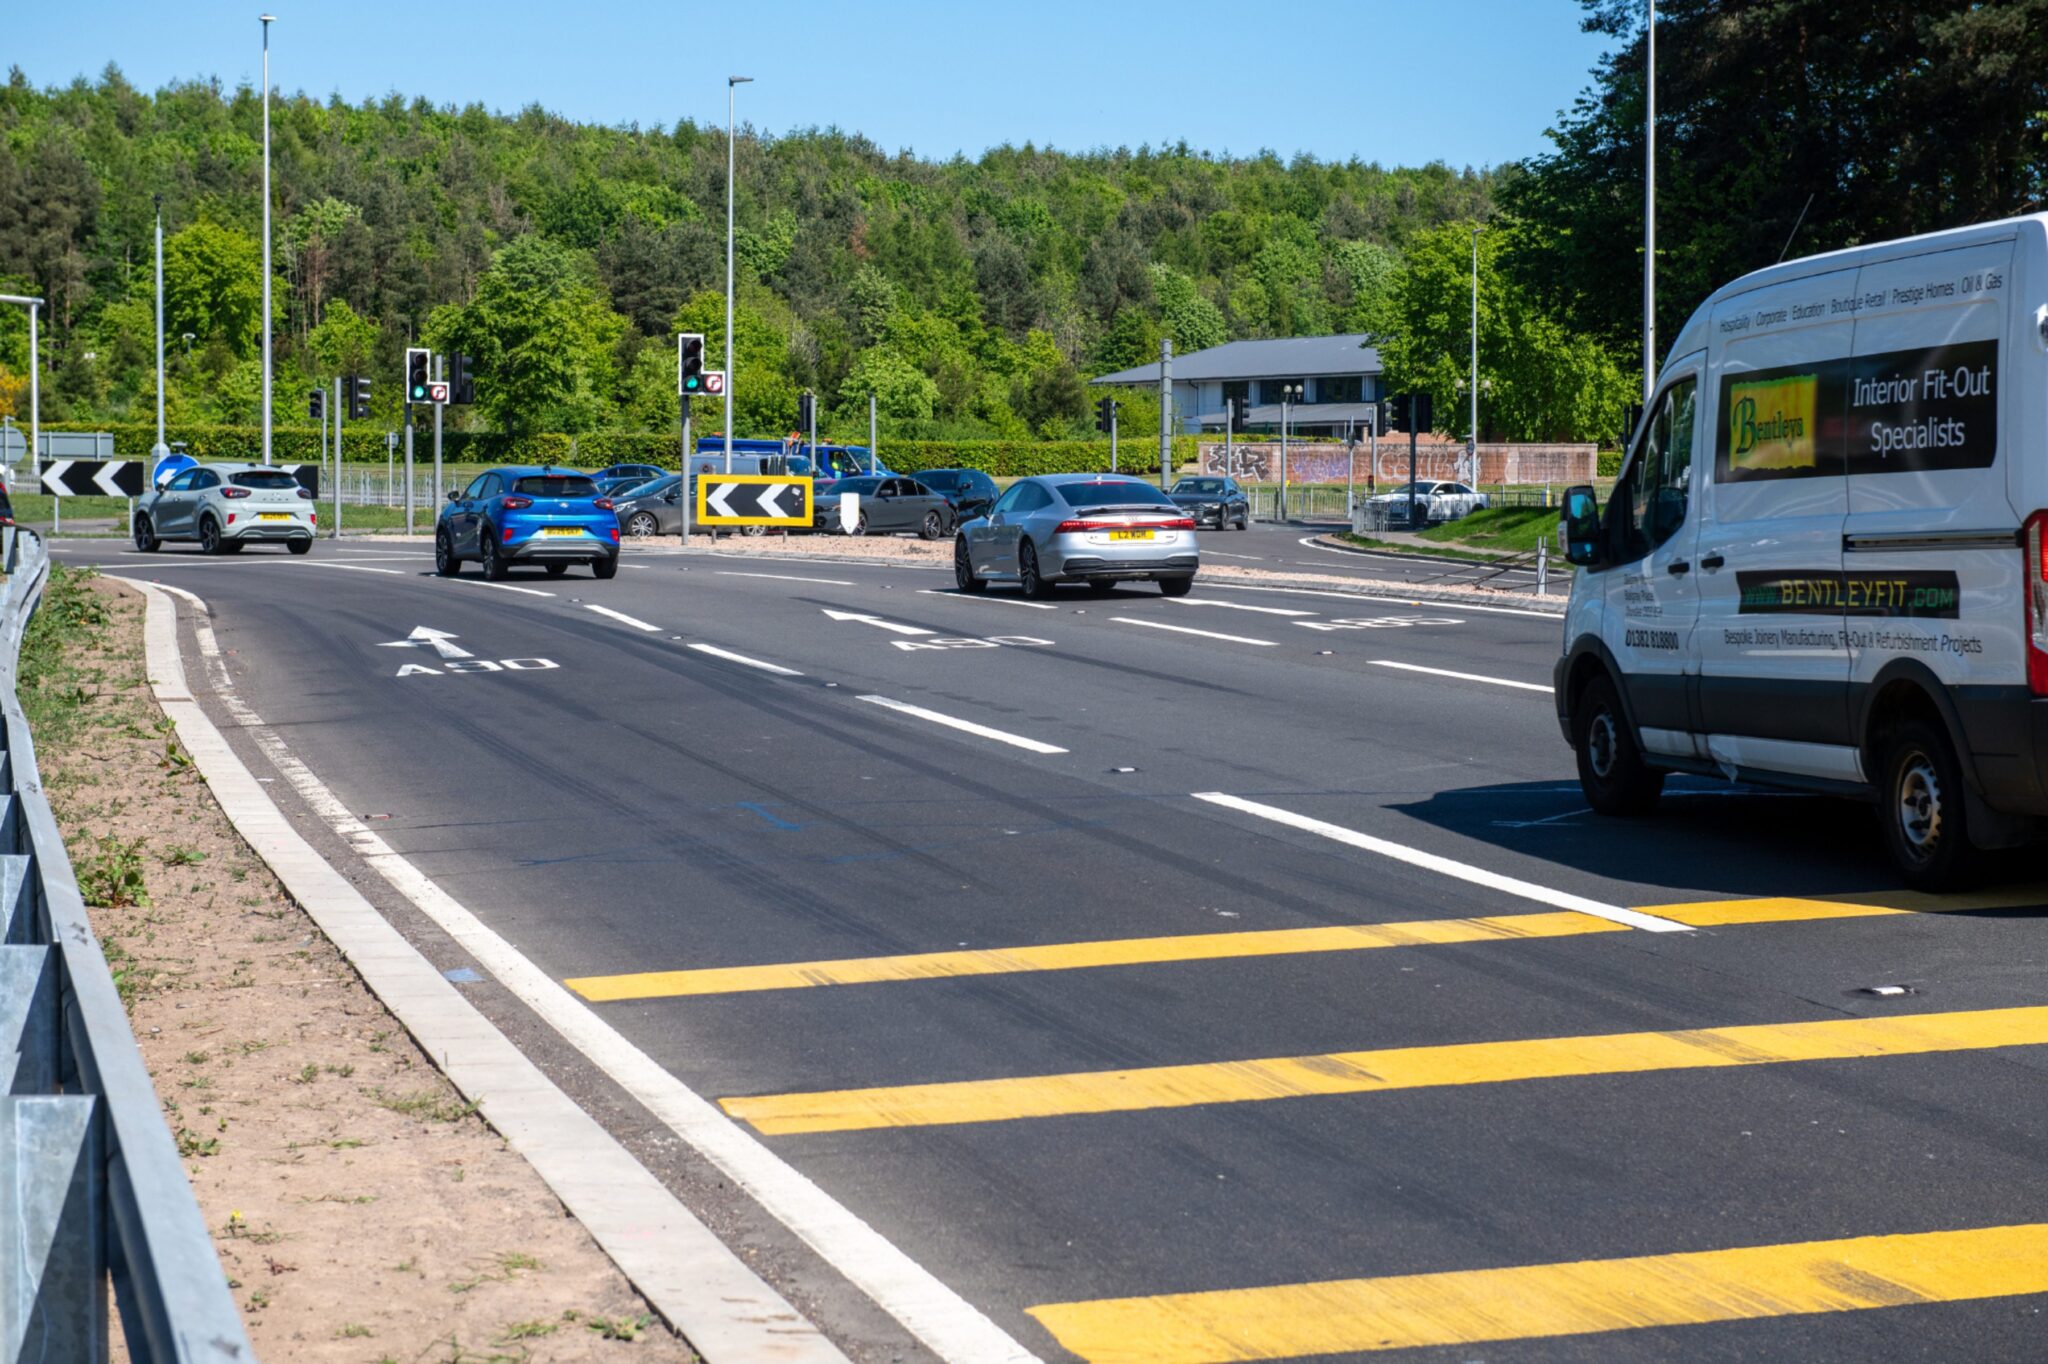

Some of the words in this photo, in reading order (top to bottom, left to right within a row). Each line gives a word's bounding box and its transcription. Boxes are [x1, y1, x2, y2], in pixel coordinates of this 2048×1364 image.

[1755, 308, 1787, 328] Corporate
[1792, 303, 1825, 320] Education
[1831, 297, 1863, 315] Boutique
[1865, 290, 1886, 308] Retail
[1892, 287, 1923, 305] Prestige
[1925, 281, 1954, 299] Homes
[1961, 276, 1974, 294] Oil
[1985, 273, 2003, 290] Gas
[1853, 374, 1918, 407] Interior
[1923, 365, 1991, 400] Fit-Out
[1733, 395, 1804, 455] Bentleys
[1870, 416, 1966, 458] Specialists
[890, 635, 1056, 651] A90
[1625, 629, 1649, 648] 01382
[1724, 629, 1753, 647] Bespoke
[1754, 629, 1780, 648] Joinery
[1838, 630, 1867, 648] Fit-Out
[1868, 632, 1875, 648] &
[1876, 632, 1938, 652] Refurbishment
[1941, 634, 1983, 656] Projects
[396, 658, 560, 677] A90
